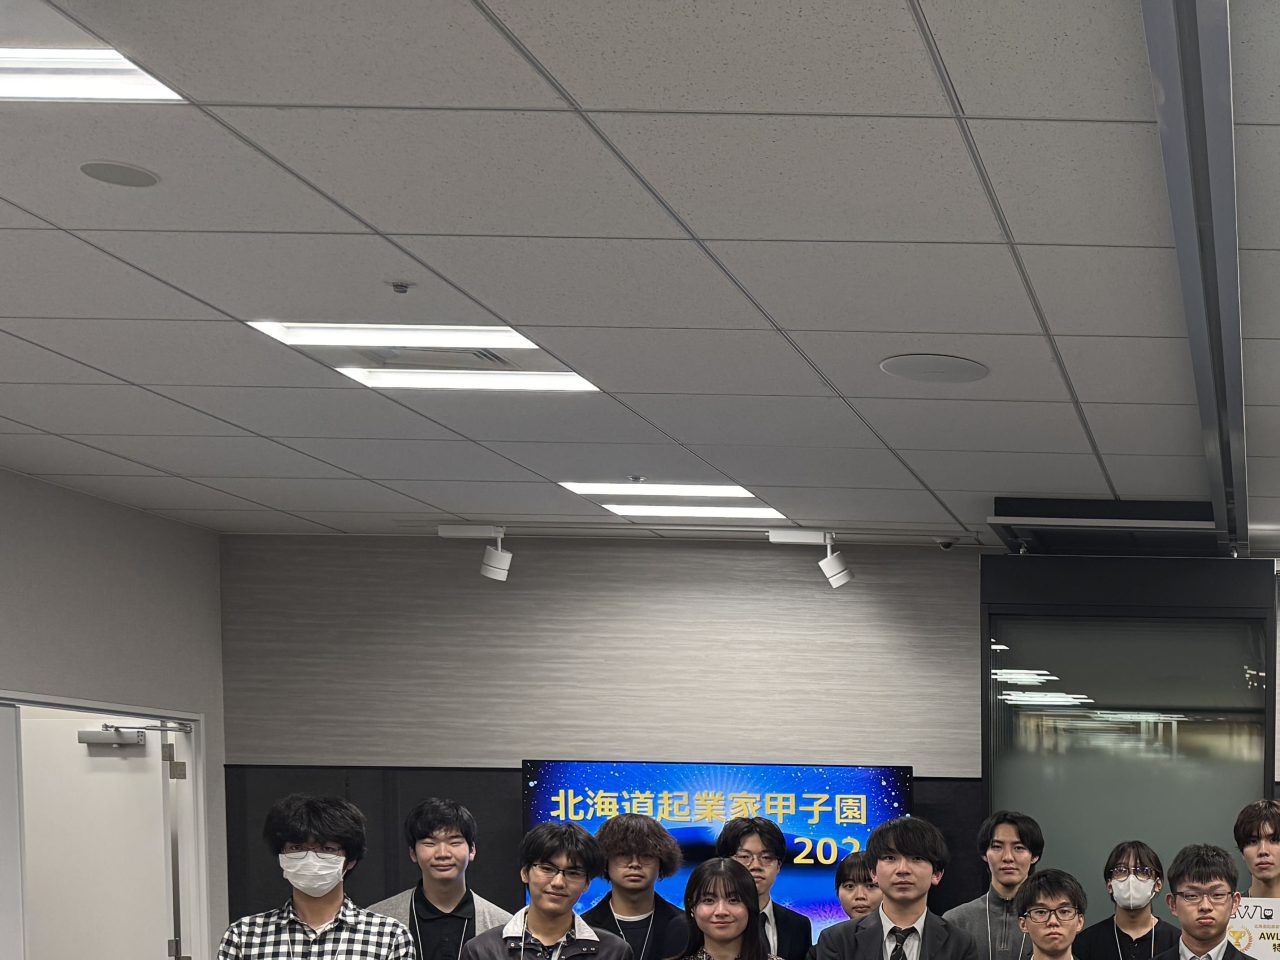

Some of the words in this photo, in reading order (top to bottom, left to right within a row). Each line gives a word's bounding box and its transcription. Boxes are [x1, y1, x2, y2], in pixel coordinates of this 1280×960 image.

[550, 788, 868, 825] 北海道起業家甲子園
